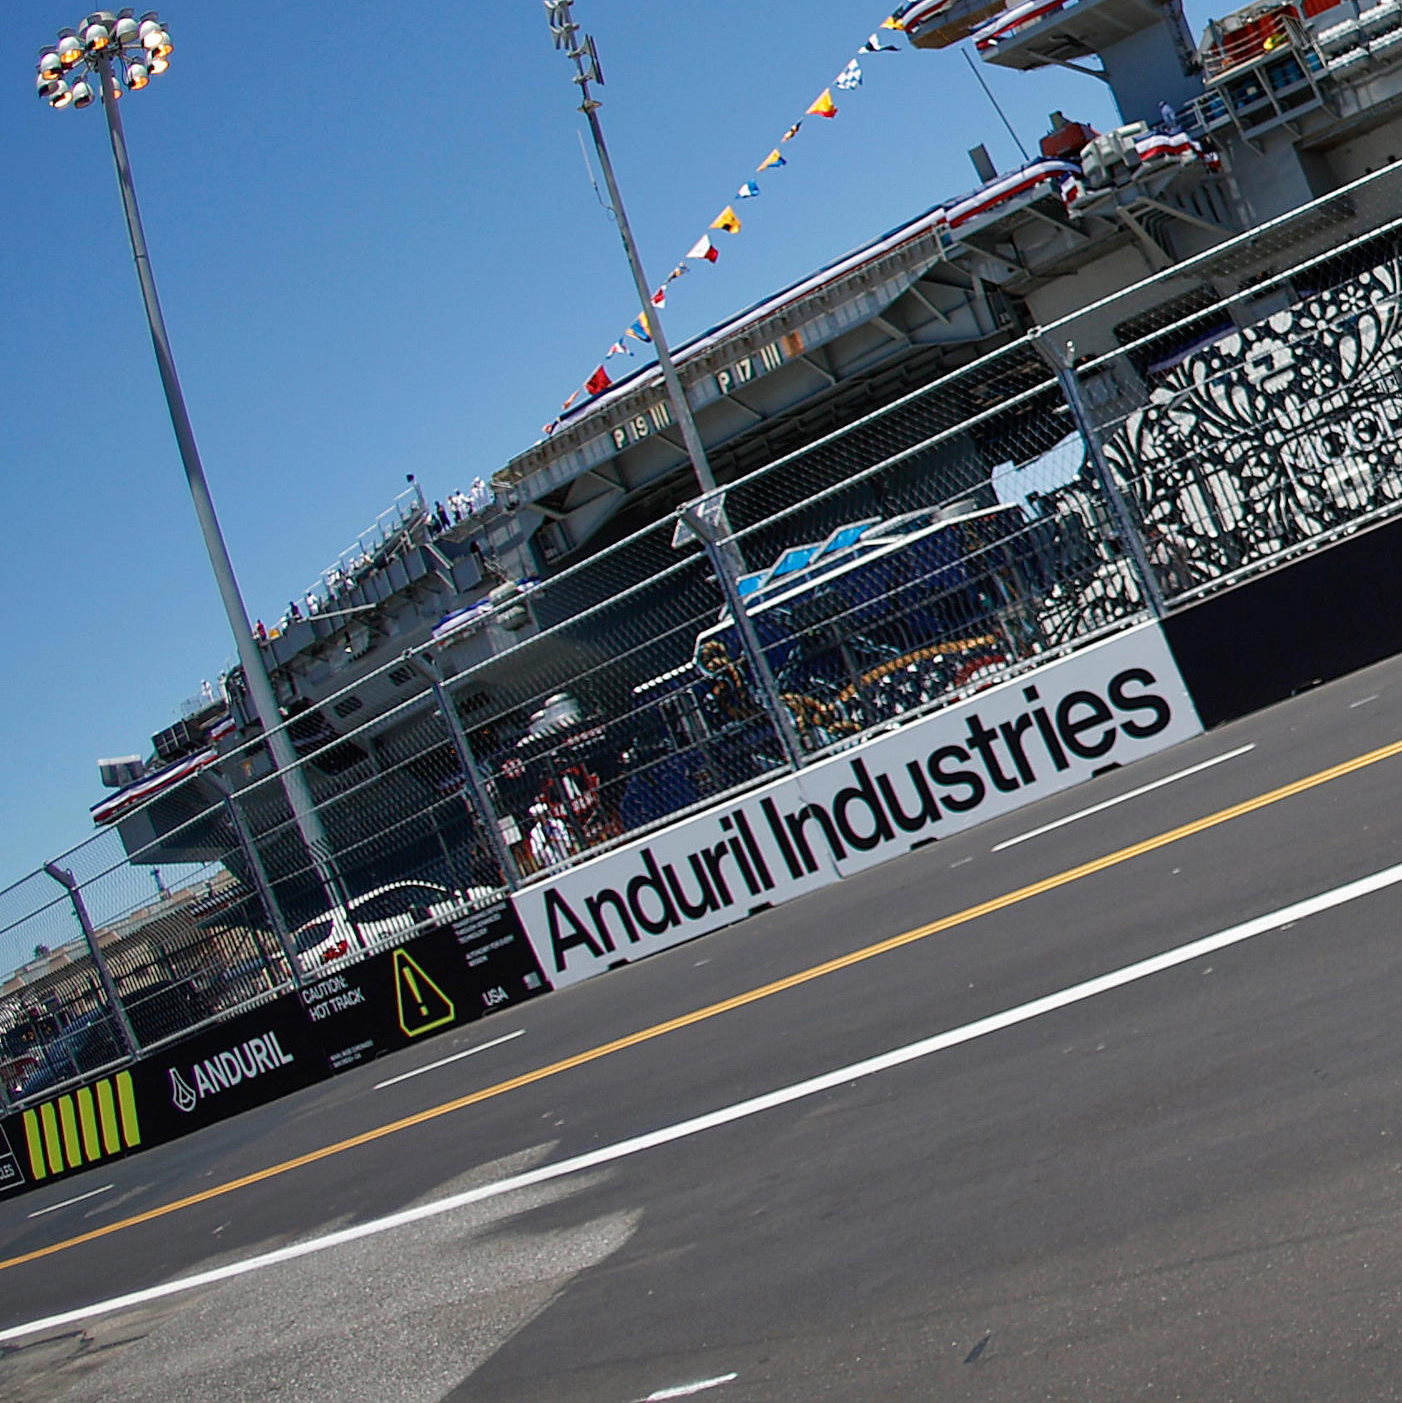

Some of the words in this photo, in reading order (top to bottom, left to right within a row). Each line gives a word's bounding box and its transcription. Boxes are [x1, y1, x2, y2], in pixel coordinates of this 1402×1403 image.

[735, 358, 752, 383] 17
[630, 416, 649, 441] 19
[543, 808, 774, 972] Anduril
[760, 666, 1172, 879] Industries
[309, 1000, 331, 1022] HOT
[329, 986, 366, 1012] TRACK
[482, 985, 509, 1006] USA
[192, 1031, 294, 1098] ANDURIL
